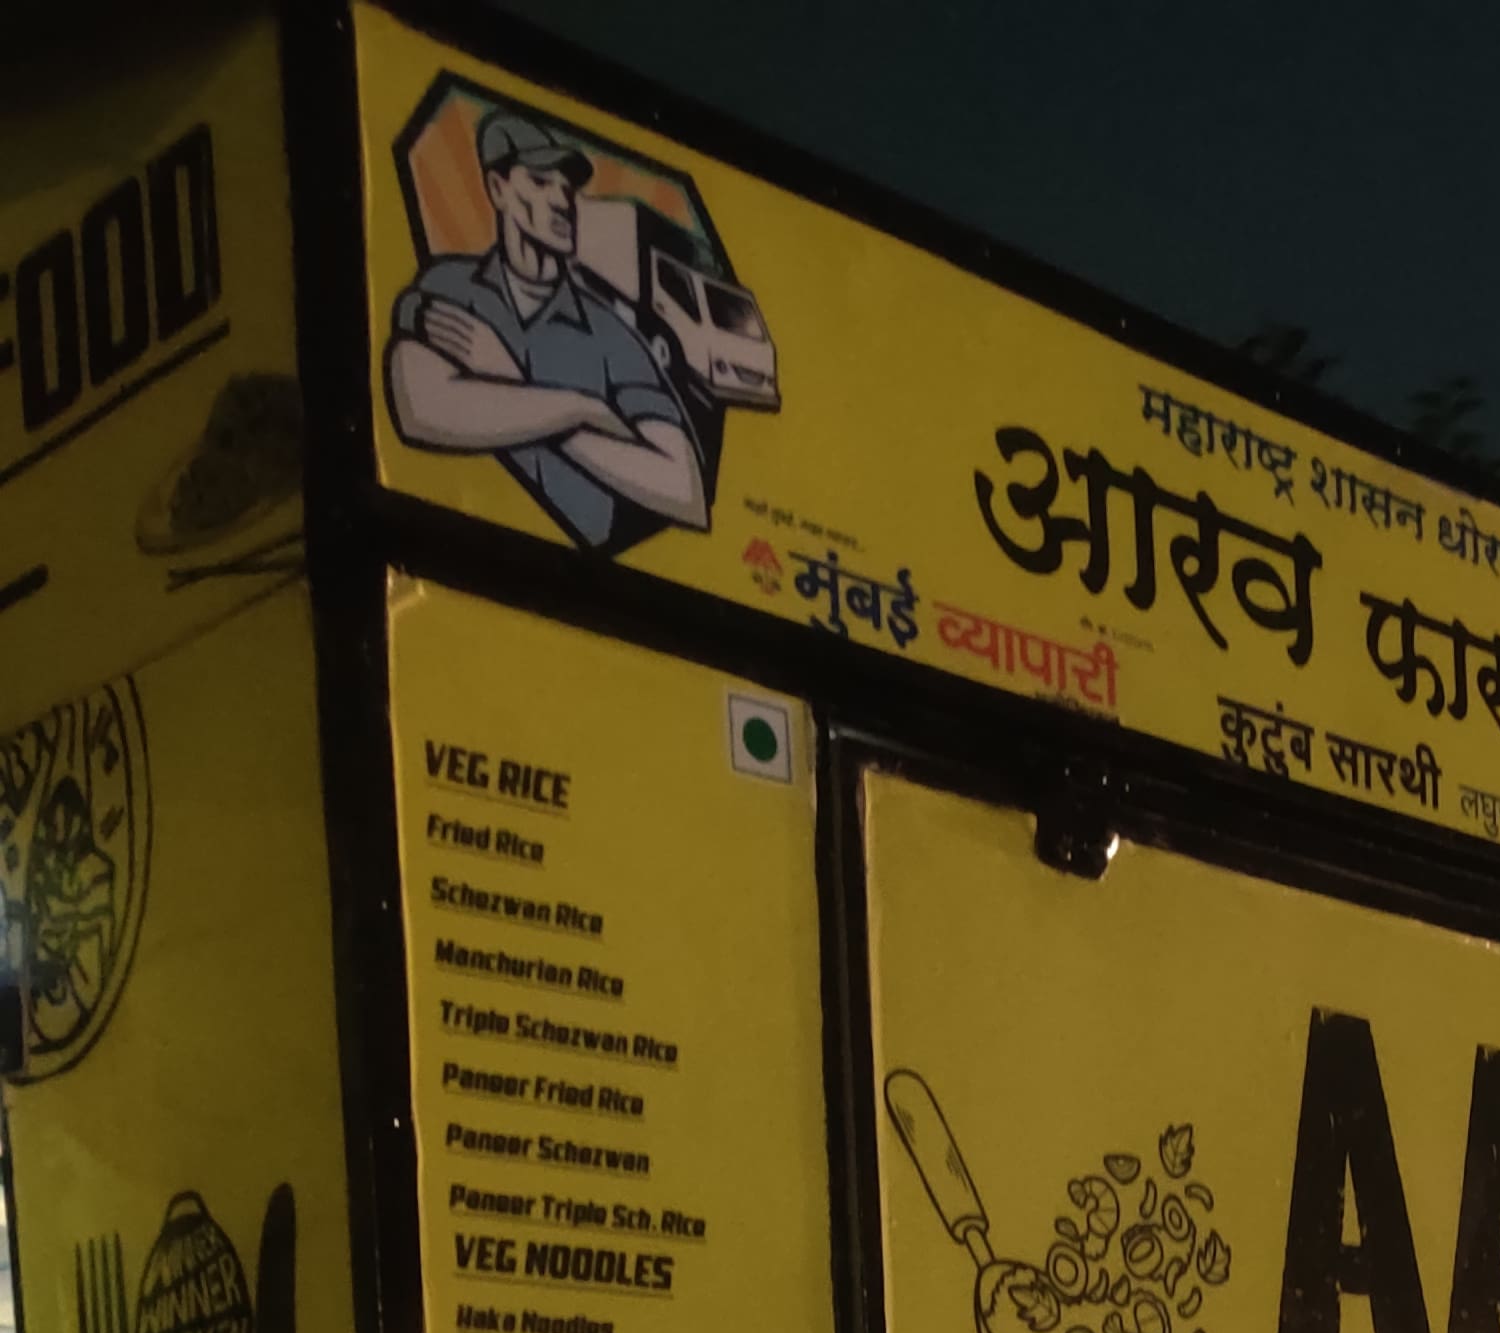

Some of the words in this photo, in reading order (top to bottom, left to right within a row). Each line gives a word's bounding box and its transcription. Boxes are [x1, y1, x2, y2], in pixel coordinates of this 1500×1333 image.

[0, 121, 222, 433] OOD
[1138, 384, 1297, 505] महाराष्ट्र
[1311, 457, 1425, 542] शासन
[788, 550, 919, 648] मुंबई
[932, 601, 1120, 705] व्यापारी
[425, 740, 489, 788] VEG
[499, 759, 571, 808] RICE
[1326, 731, 1443, 810] सारथी
[427, 814, 490, 850] Fried
[495, 831, 544, 863] Rice
[431, 877, 550, 924] Schezwan
[555, 904, 603, 935] Rice
[435, 939, 572, 987] Manchurian
[577, 968, 624, 997] Rice
[441, 1001, 509, 1035] Triple
[515, 1014, 628, 1055] Schezwan
[633, 1036, 678, 1062] Rice
[443, 1062, 529, 1099] Paneer
[534, 1076, 593, 1109] Fried
[598, 1088, 643, 1115] Rice
[446, 1124, 532, 1159] Paneer
[537, 1136, 651, 1173] Schezwan
[449, 1184, 536, 1218] Paneer
[542, 1195, 606, 1228] Triple
[661, 1210, 705, 1237] Rice
[455, 1234, 516, 1273] VEG
[524, 1241, 674, 1290] NOODLES
